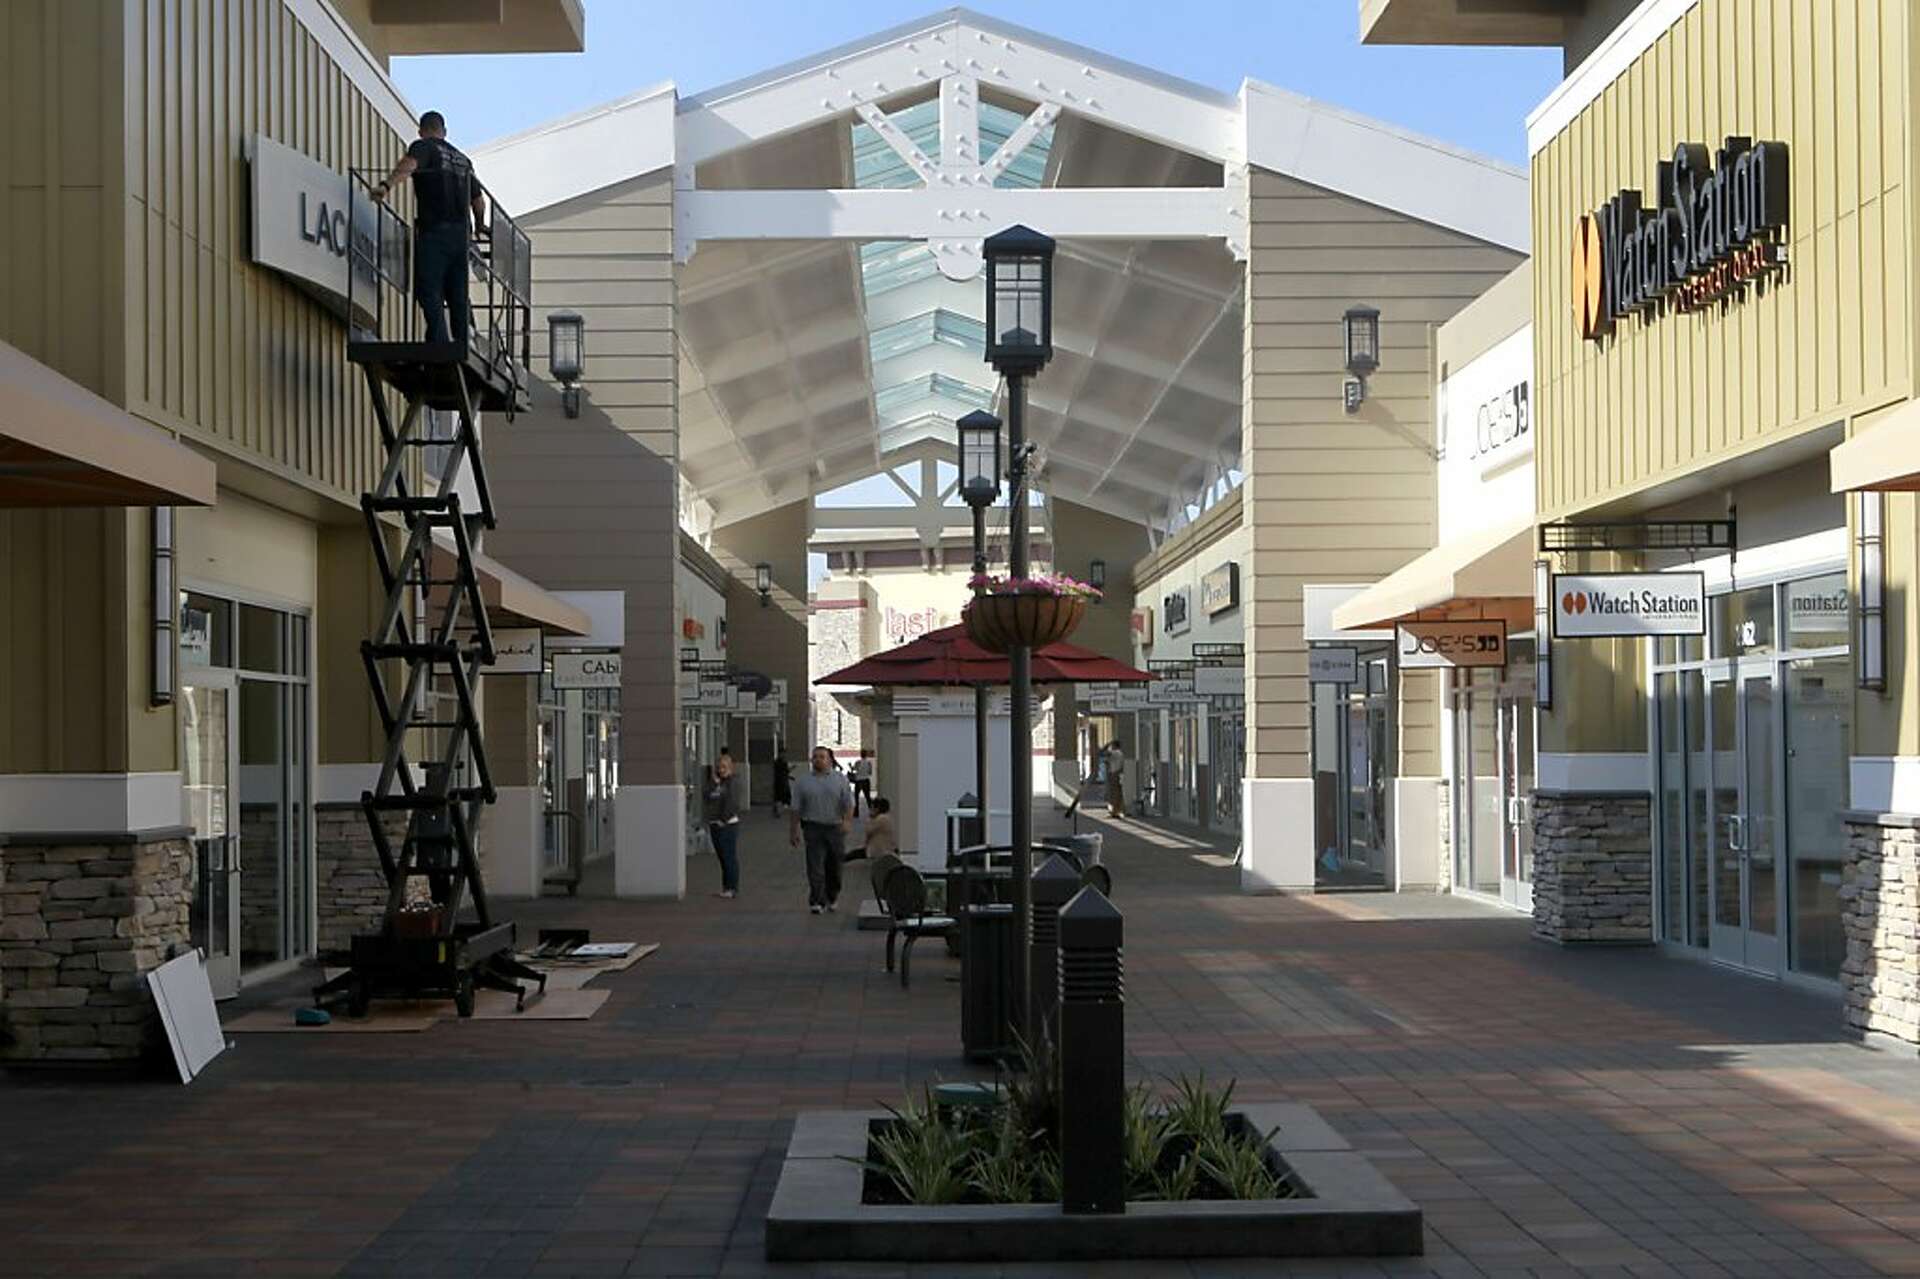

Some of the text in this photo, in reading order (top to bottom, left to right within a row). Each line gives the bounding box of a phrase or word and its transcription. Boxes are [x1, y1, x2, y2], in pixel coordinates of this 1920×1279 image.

[1598, 137, 1788, 321] Watch Station
[1589, 590, 1698, 614] Watch Station
[1404, 635, 1475, 655] JOE'S
